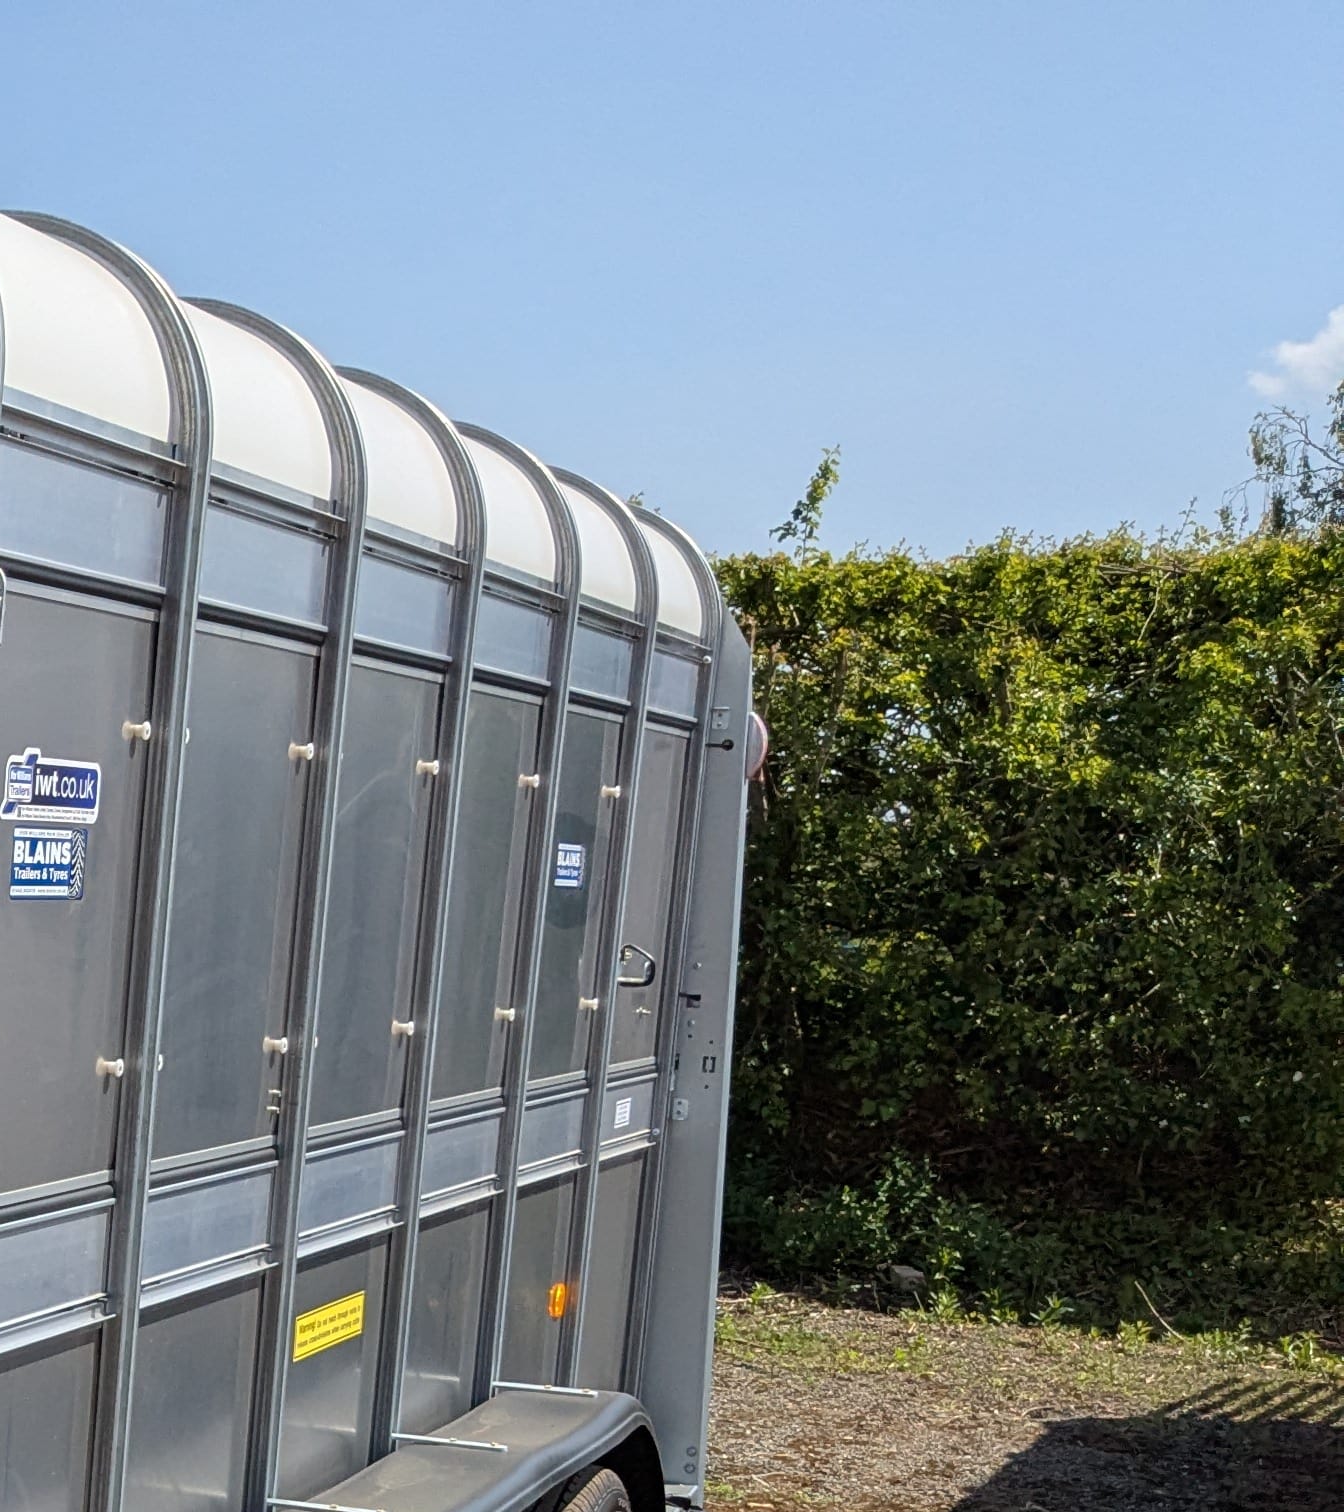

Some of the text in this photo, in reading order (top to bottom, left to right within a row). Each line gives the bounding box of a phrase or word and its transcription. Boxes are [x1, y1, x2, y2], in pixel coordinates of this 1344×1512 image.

[34, 768, 94, 800] iwt.co.uk
[13, 840, 72, 865] BLAINS
[14, 867, 41, 880] Trailers
[49, 867, 69, 883] Tyres
